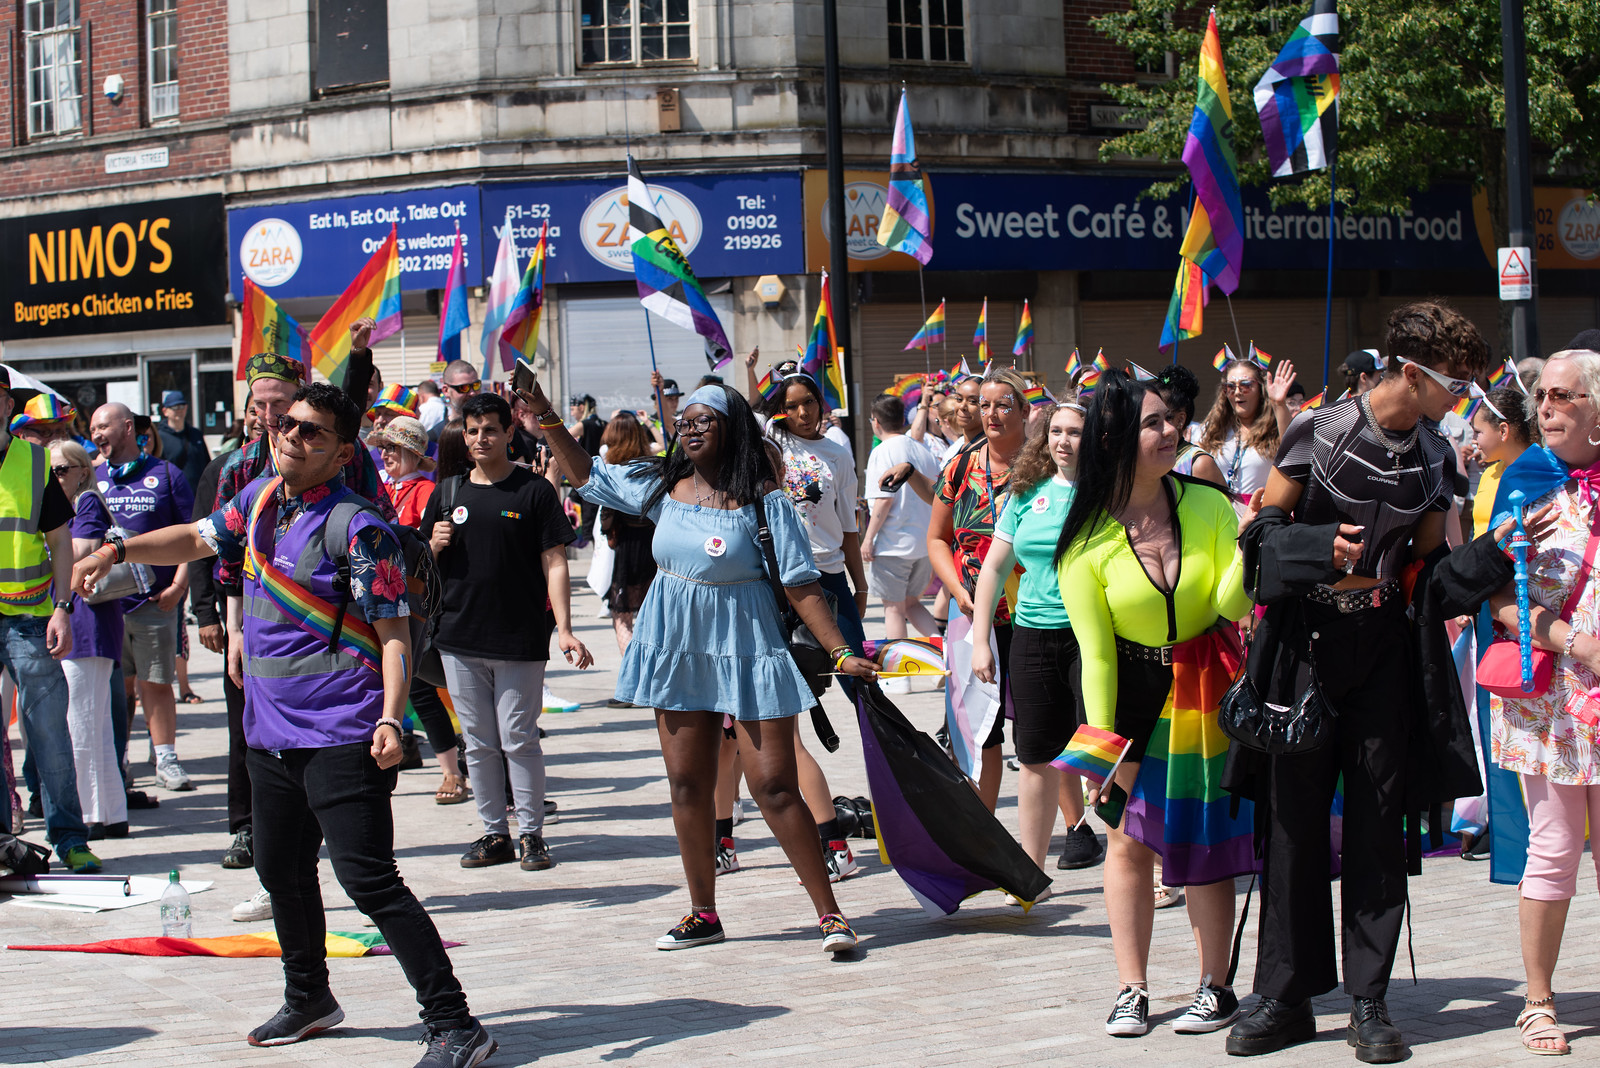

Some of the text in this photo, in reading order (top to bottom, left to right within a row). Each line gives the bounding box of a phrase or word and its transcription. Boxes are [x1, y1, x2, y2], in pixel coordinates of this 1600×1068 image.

[106, 151, 166, 169] VICTORIA STREET
[505, 203, 551, 219] 51-52
[737, 194, 766, 210] Tel:
[309, 214, 331, 230] Eat
[333, 211, 349, 229] In,
[351, 209, 372, 226] Eat
[406, 203, 439, 221] Take
[440, 200, 467, 218] Out
[727, 214, 778, 231] 01902
[955, 202, 1060, 239] Sweet
[1067, 203, 1147, 239] Café
[1152, 206, 1174, 239] &
[1400, 209, 1462, 242] Food
[492, 224, 561, 240] Vctoria
[596, 219, 688, 247] ZAA
[407, 232, 468, 251] welcome
[724, 234, 782, 250] 219926
[29, 217, 173, 285] NIMO'S
[249, 246, 294, 267] ZARA
[14, 288, 194, 326] Burgers Chicken Fries
[1367, 475, 1399, 486] COURAGE
[125, 504, 155, 512] PRIDE
